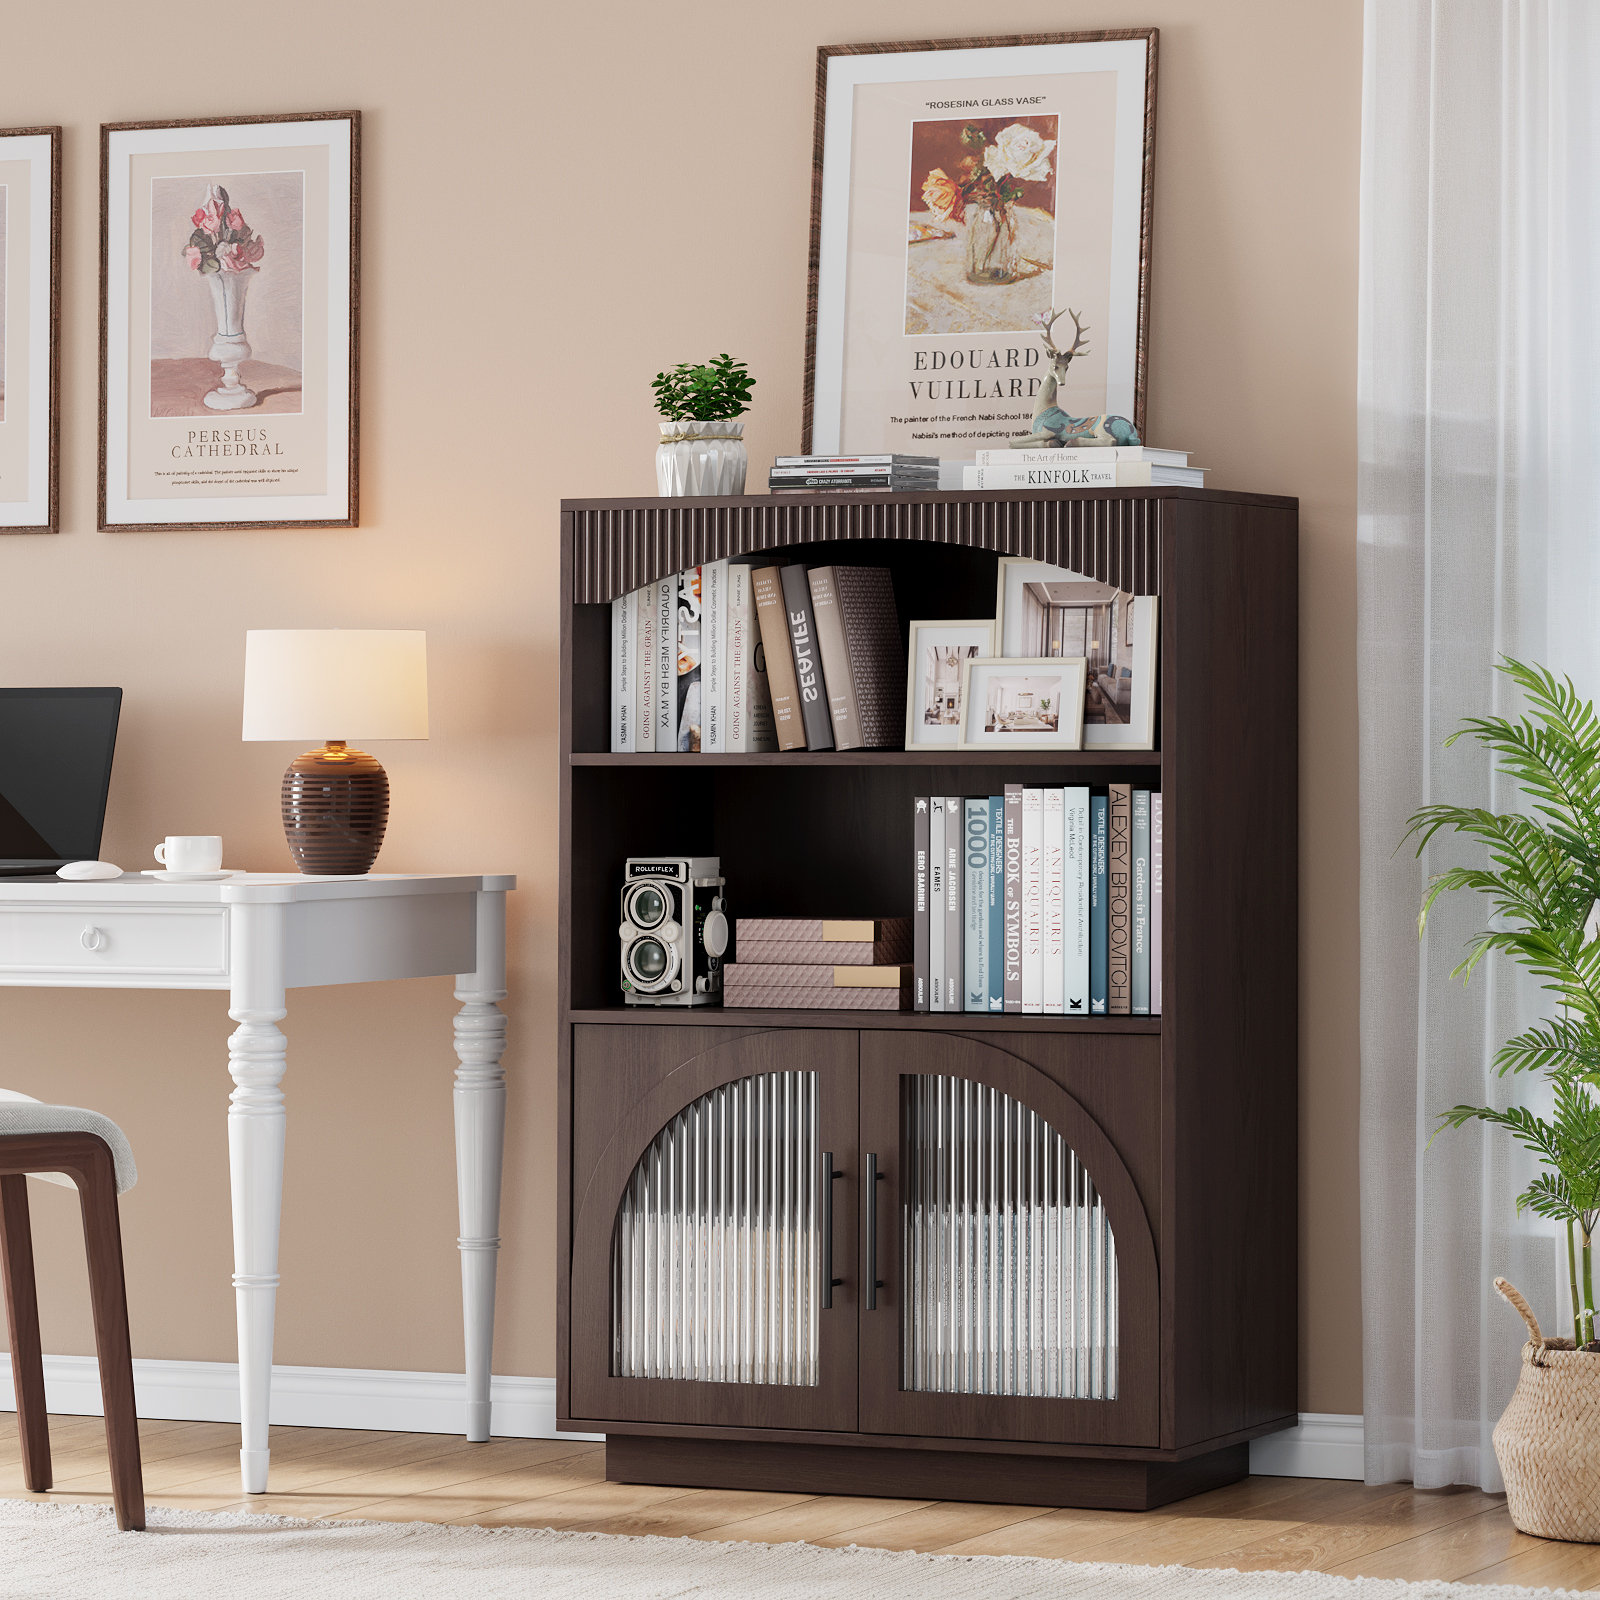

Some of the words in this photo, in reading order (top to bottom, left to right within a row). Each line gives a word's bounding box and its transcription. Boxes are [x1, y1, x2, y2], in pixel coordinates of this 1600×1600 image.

[981, 98, 1014, 107] GLASS
[913, 348, 1039, 371] EDOUARD
[908, 377, 1042, 400] VUILLARD
[904, 416, 929, 424] painter
[978, 413, 996, 421] Nabi
[996, 412, 1021, 421] School
[171, 443, 284, 458] CATHEDRAL
[188, 429, 267, 443] PERSEUS
[940, 431, 967, 439] method
[968, 430, 976, 438] of
[977, 430, 1010, 439] depicting
[1022, 454, 1036, 462] The
[1037, 454, 1048, 462] Art
[1049, 453, 1057, 464] of
[1057, 454, 1078, 462] Home
[1014, 474, 1025, 482] THE
[1028, 469, 1090, 484] KINFOLK
[643, 670, 651, 708] AGAINST
[733, 670, 741, 708] AGAINST
[732, 711, 740, 740] GOING
[967, 807, 988, 869] 1000
[1111, 790, 1127, 866] ALEXEY
[917, 850, 926, 870] EERO
[1007, 838, 1019, 884] BOOK
[917, 873, 926, 912] SAARINEN
[1136, 857, 1145, 901] Gardens
[1027, 848, 1039, 955] ANTIQUAIRES
[1049, 848, 1061, 955] ANTIQUAIRES
[1136, 904, 1145, 914] in
[1007, 900, 1019, 981] SYMBOLS
[1111, 872, 1127, 998] BRODOVITCH
[1136, 918, 1145, 954] France
